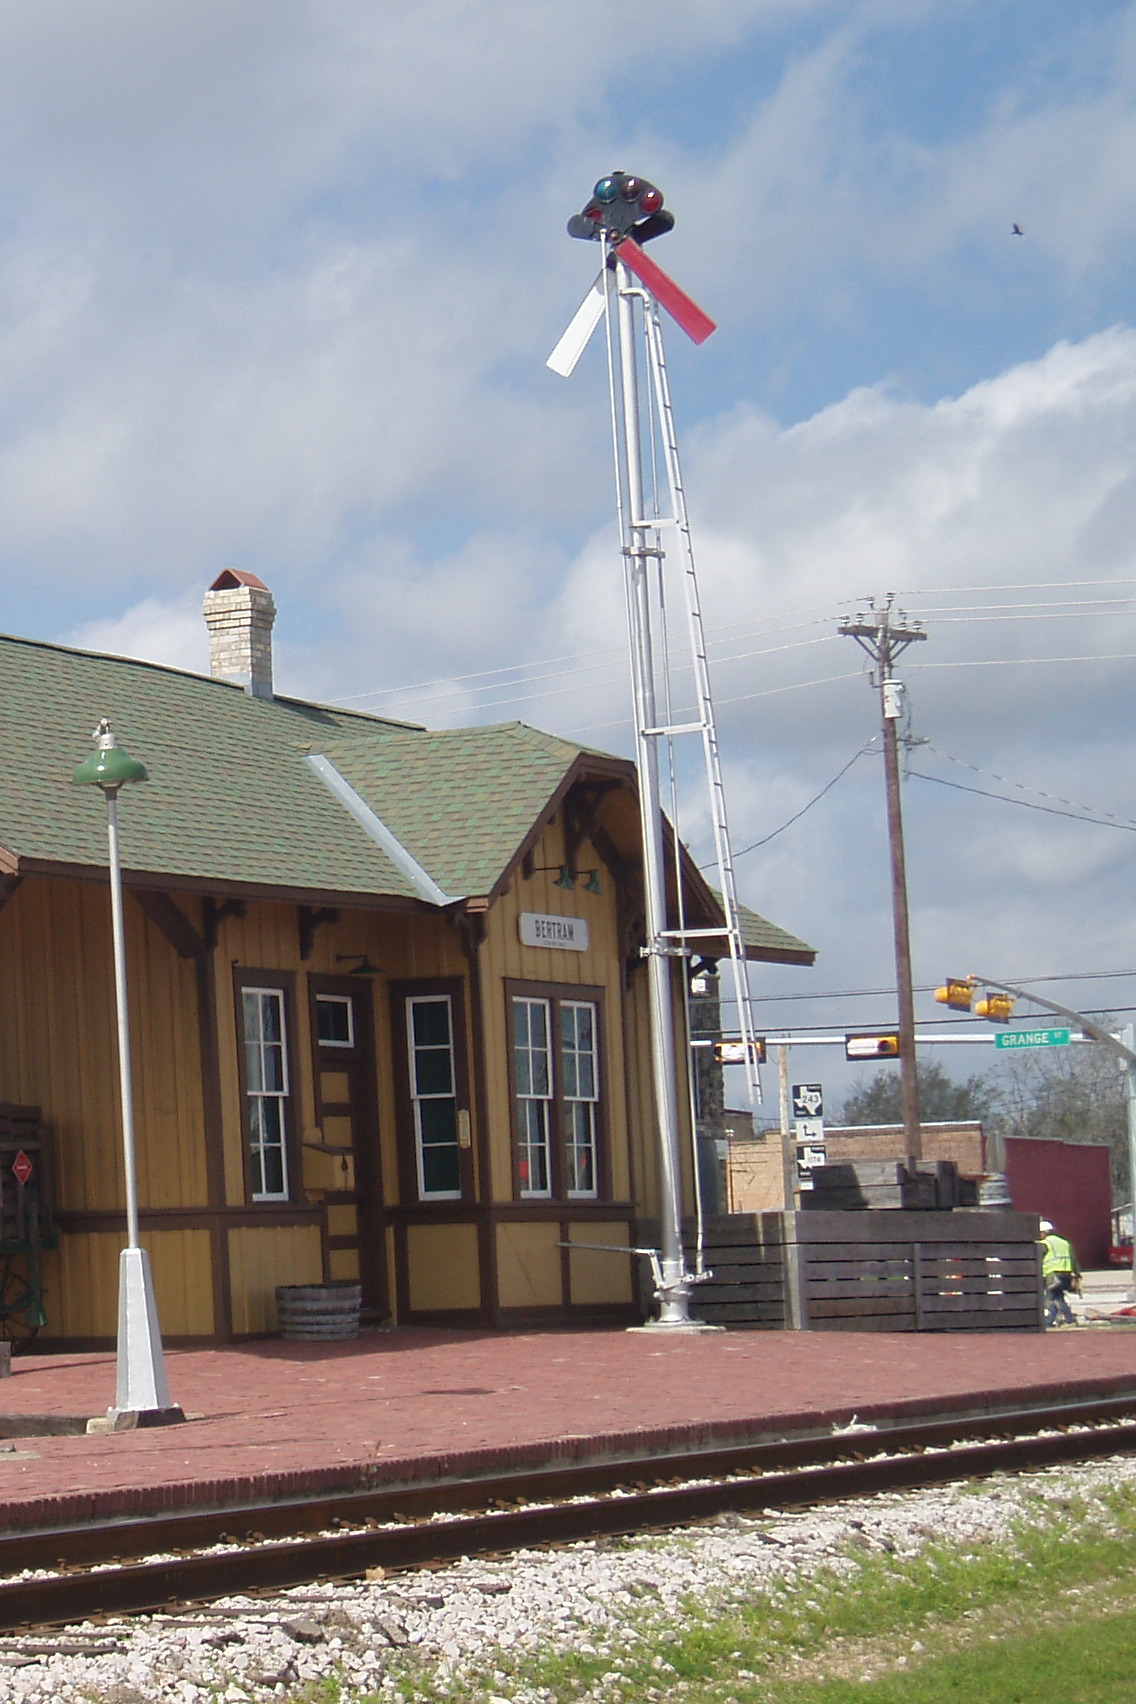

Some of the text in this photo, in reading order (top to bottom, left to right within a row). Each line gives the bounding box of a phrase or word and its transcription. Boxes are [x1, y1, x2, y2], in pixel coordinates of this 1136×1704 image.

[535, 920, 574, 940] BERTRAM
[1002, 1033, 1049, 1046] GRANGE
[802, 1094, 819, 1104] 243
